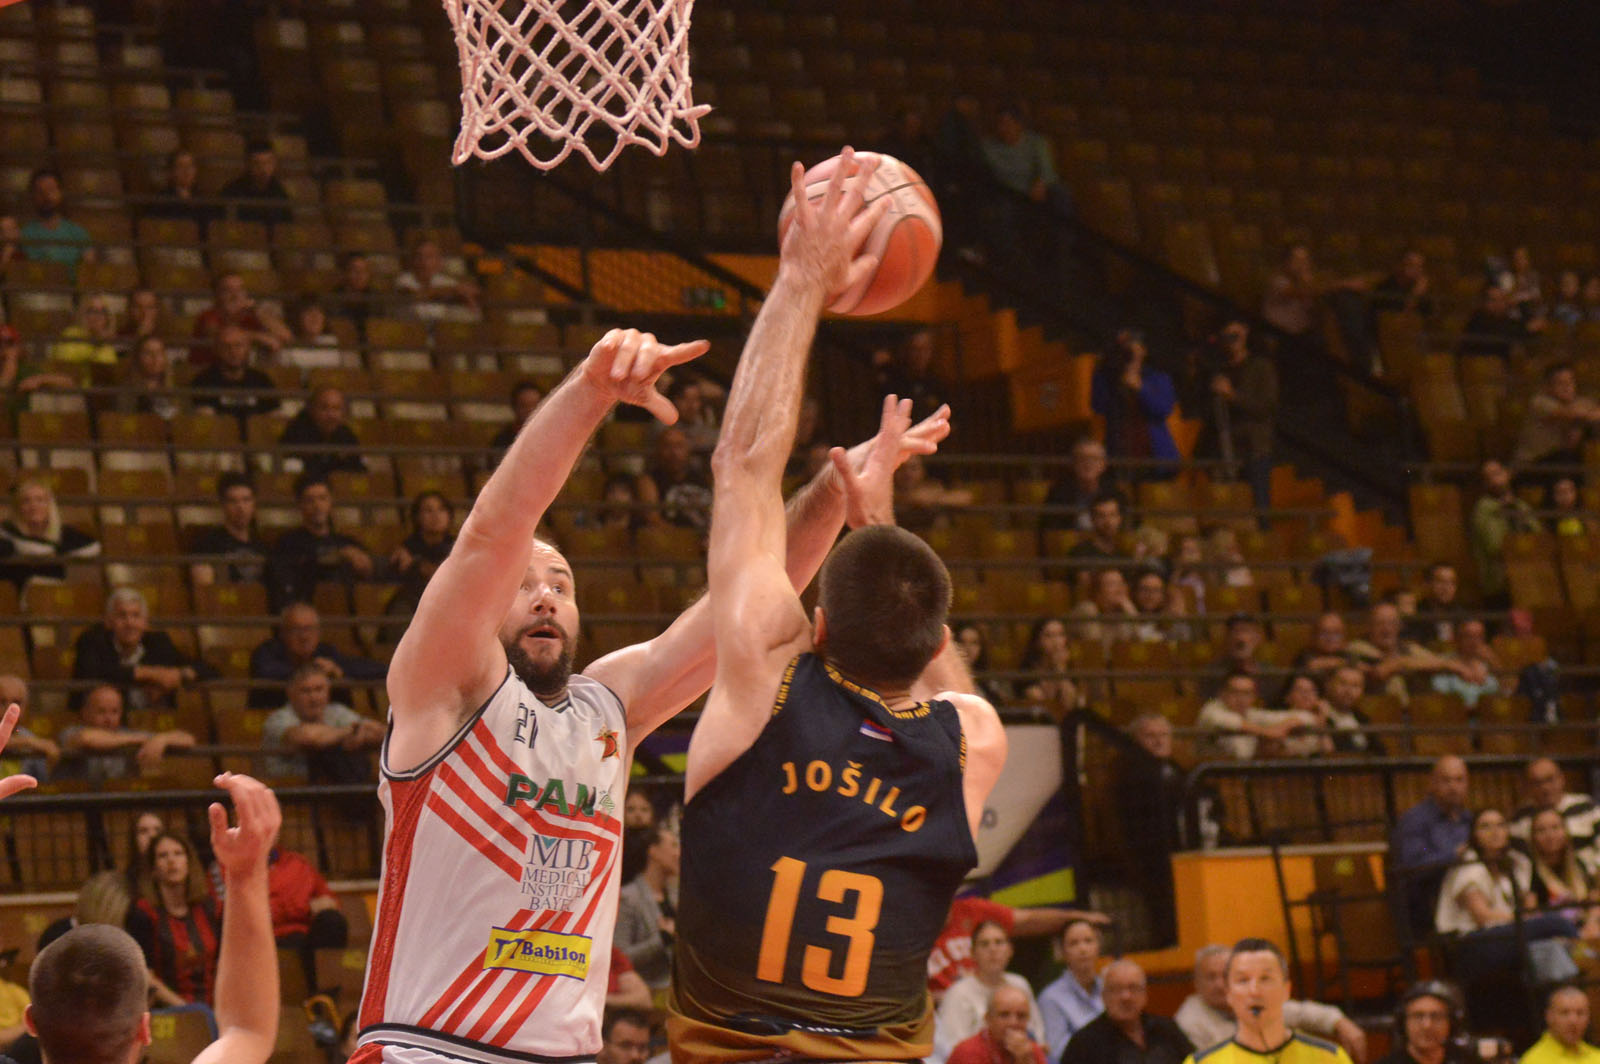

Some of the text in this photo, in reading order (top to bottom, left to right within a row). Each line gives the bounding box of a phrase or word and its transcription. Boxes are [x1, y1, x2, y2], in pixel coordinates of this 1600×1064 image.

[782, 760, 927, 832] JOŠILO
[527, 833, 594, 870] MIB
[521, 941, 586, 964] Babilon
[757, 856, 884, 998] 13
